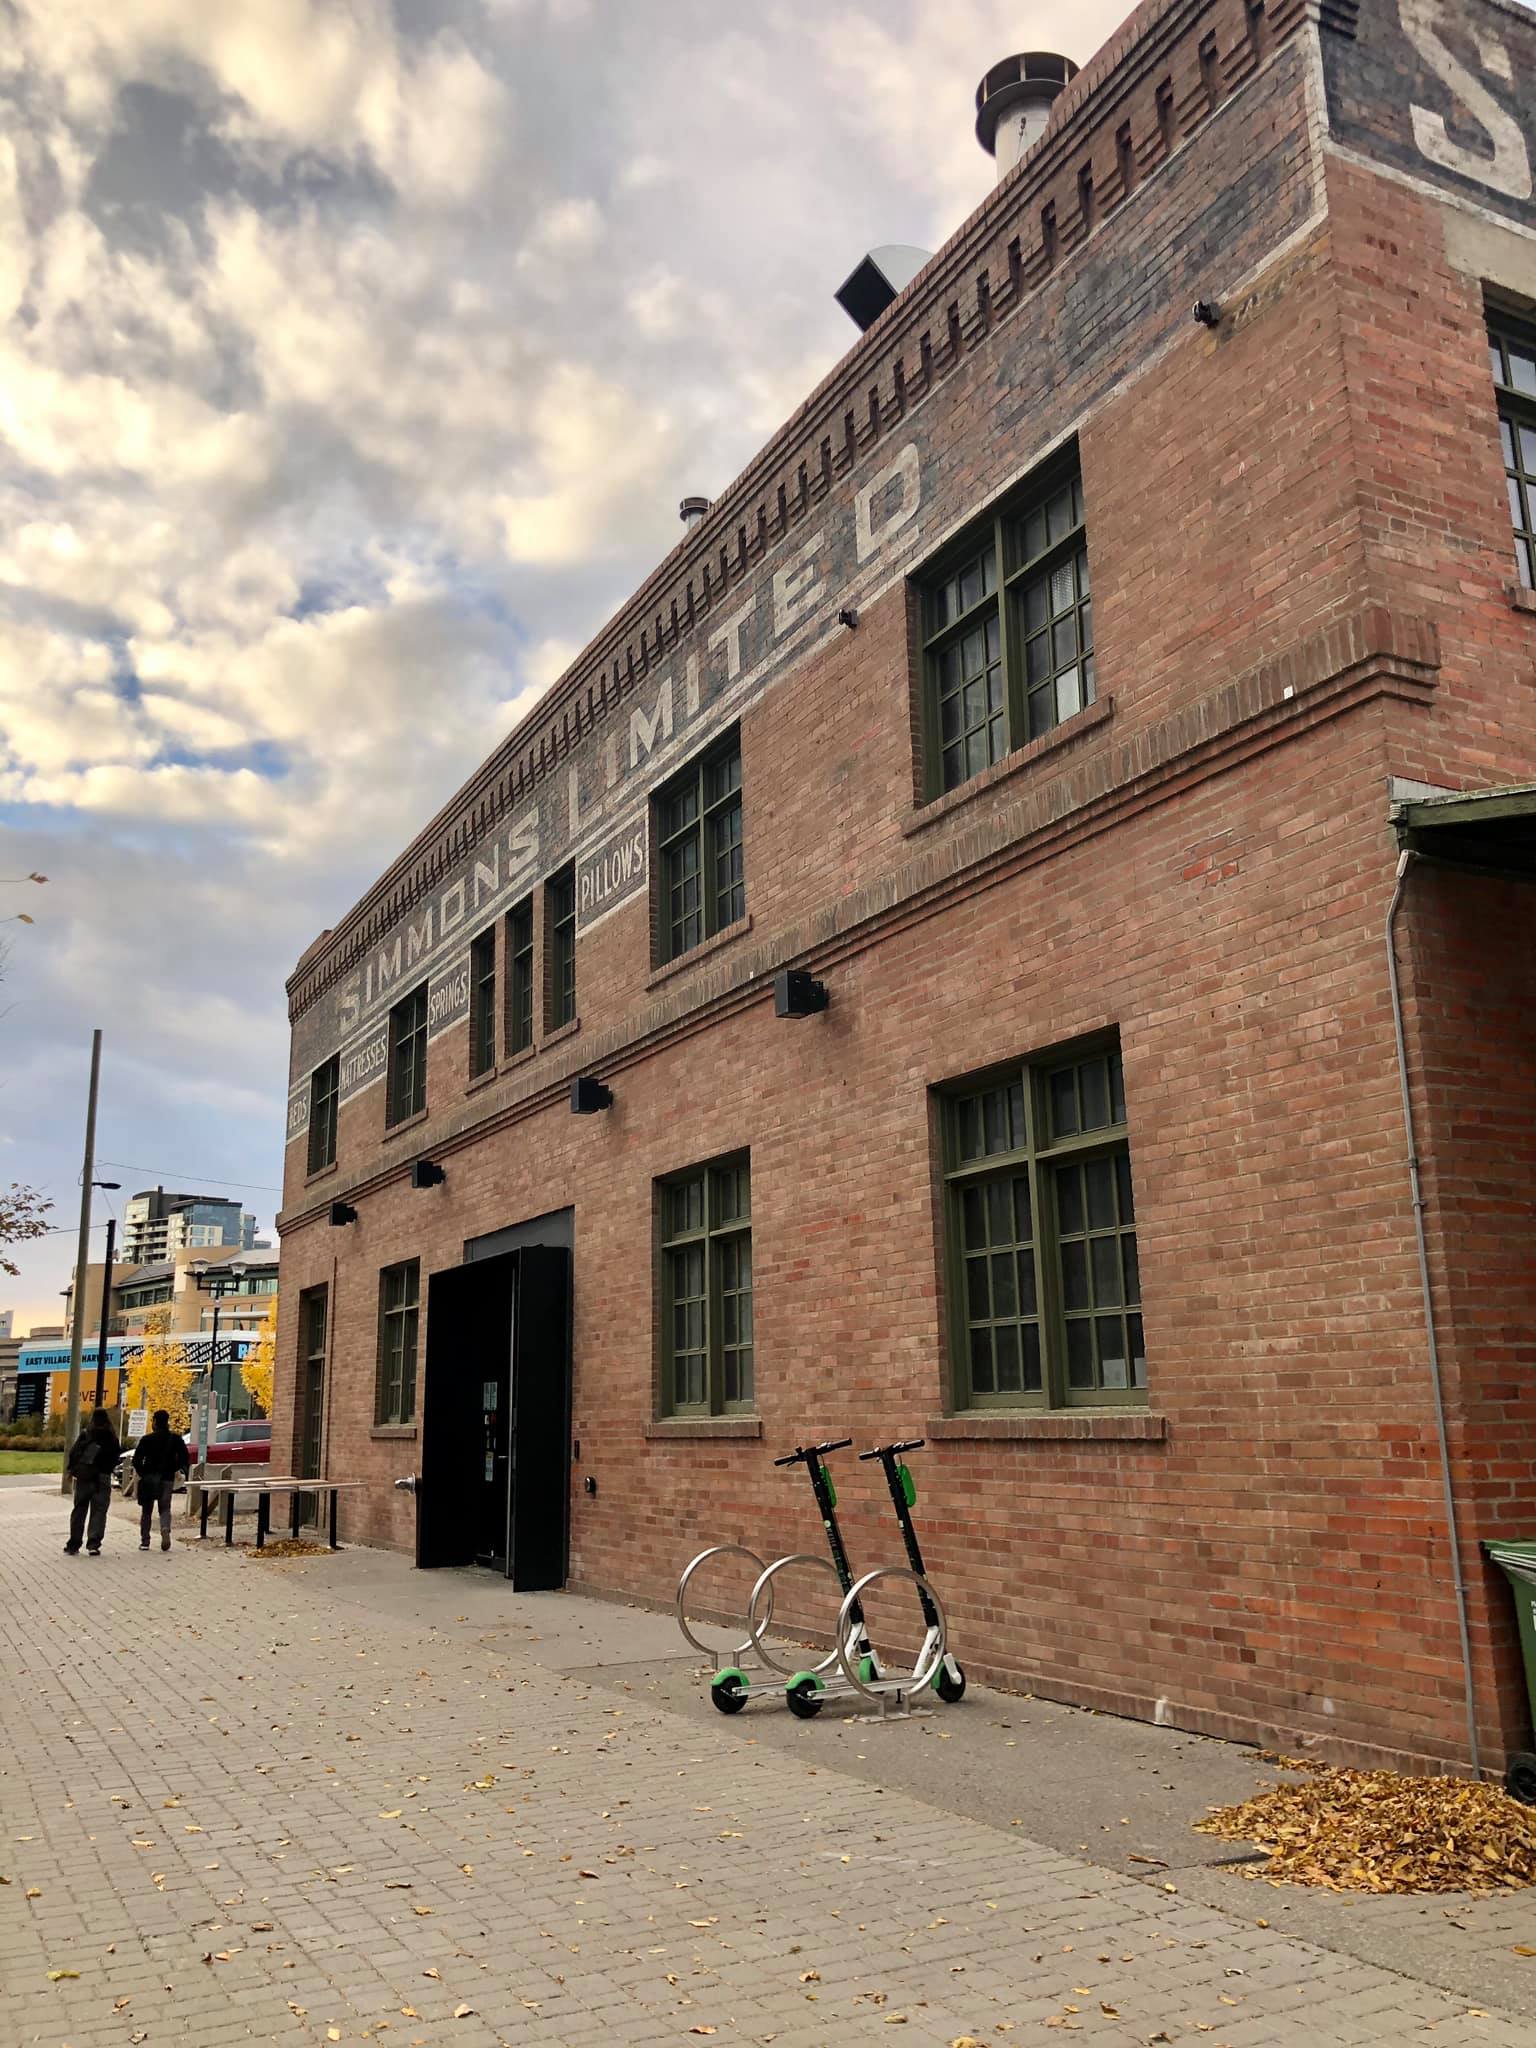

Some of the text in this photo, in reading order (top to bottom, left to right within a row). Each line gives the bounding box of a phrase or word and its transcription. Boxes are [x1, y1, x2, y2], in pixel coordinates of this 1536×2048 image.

[336, 442, 919, 1035] SIMMONS LIMITED
[581, 831, 644, 913] PILLOWS
[430, 970, 468, 1025] SPRINGS
[26, 1357, 42, 1366] EAST
[43, 1355, 71, 1365] VILLAGE
[81, 1353, 114, 1363] HARVST
